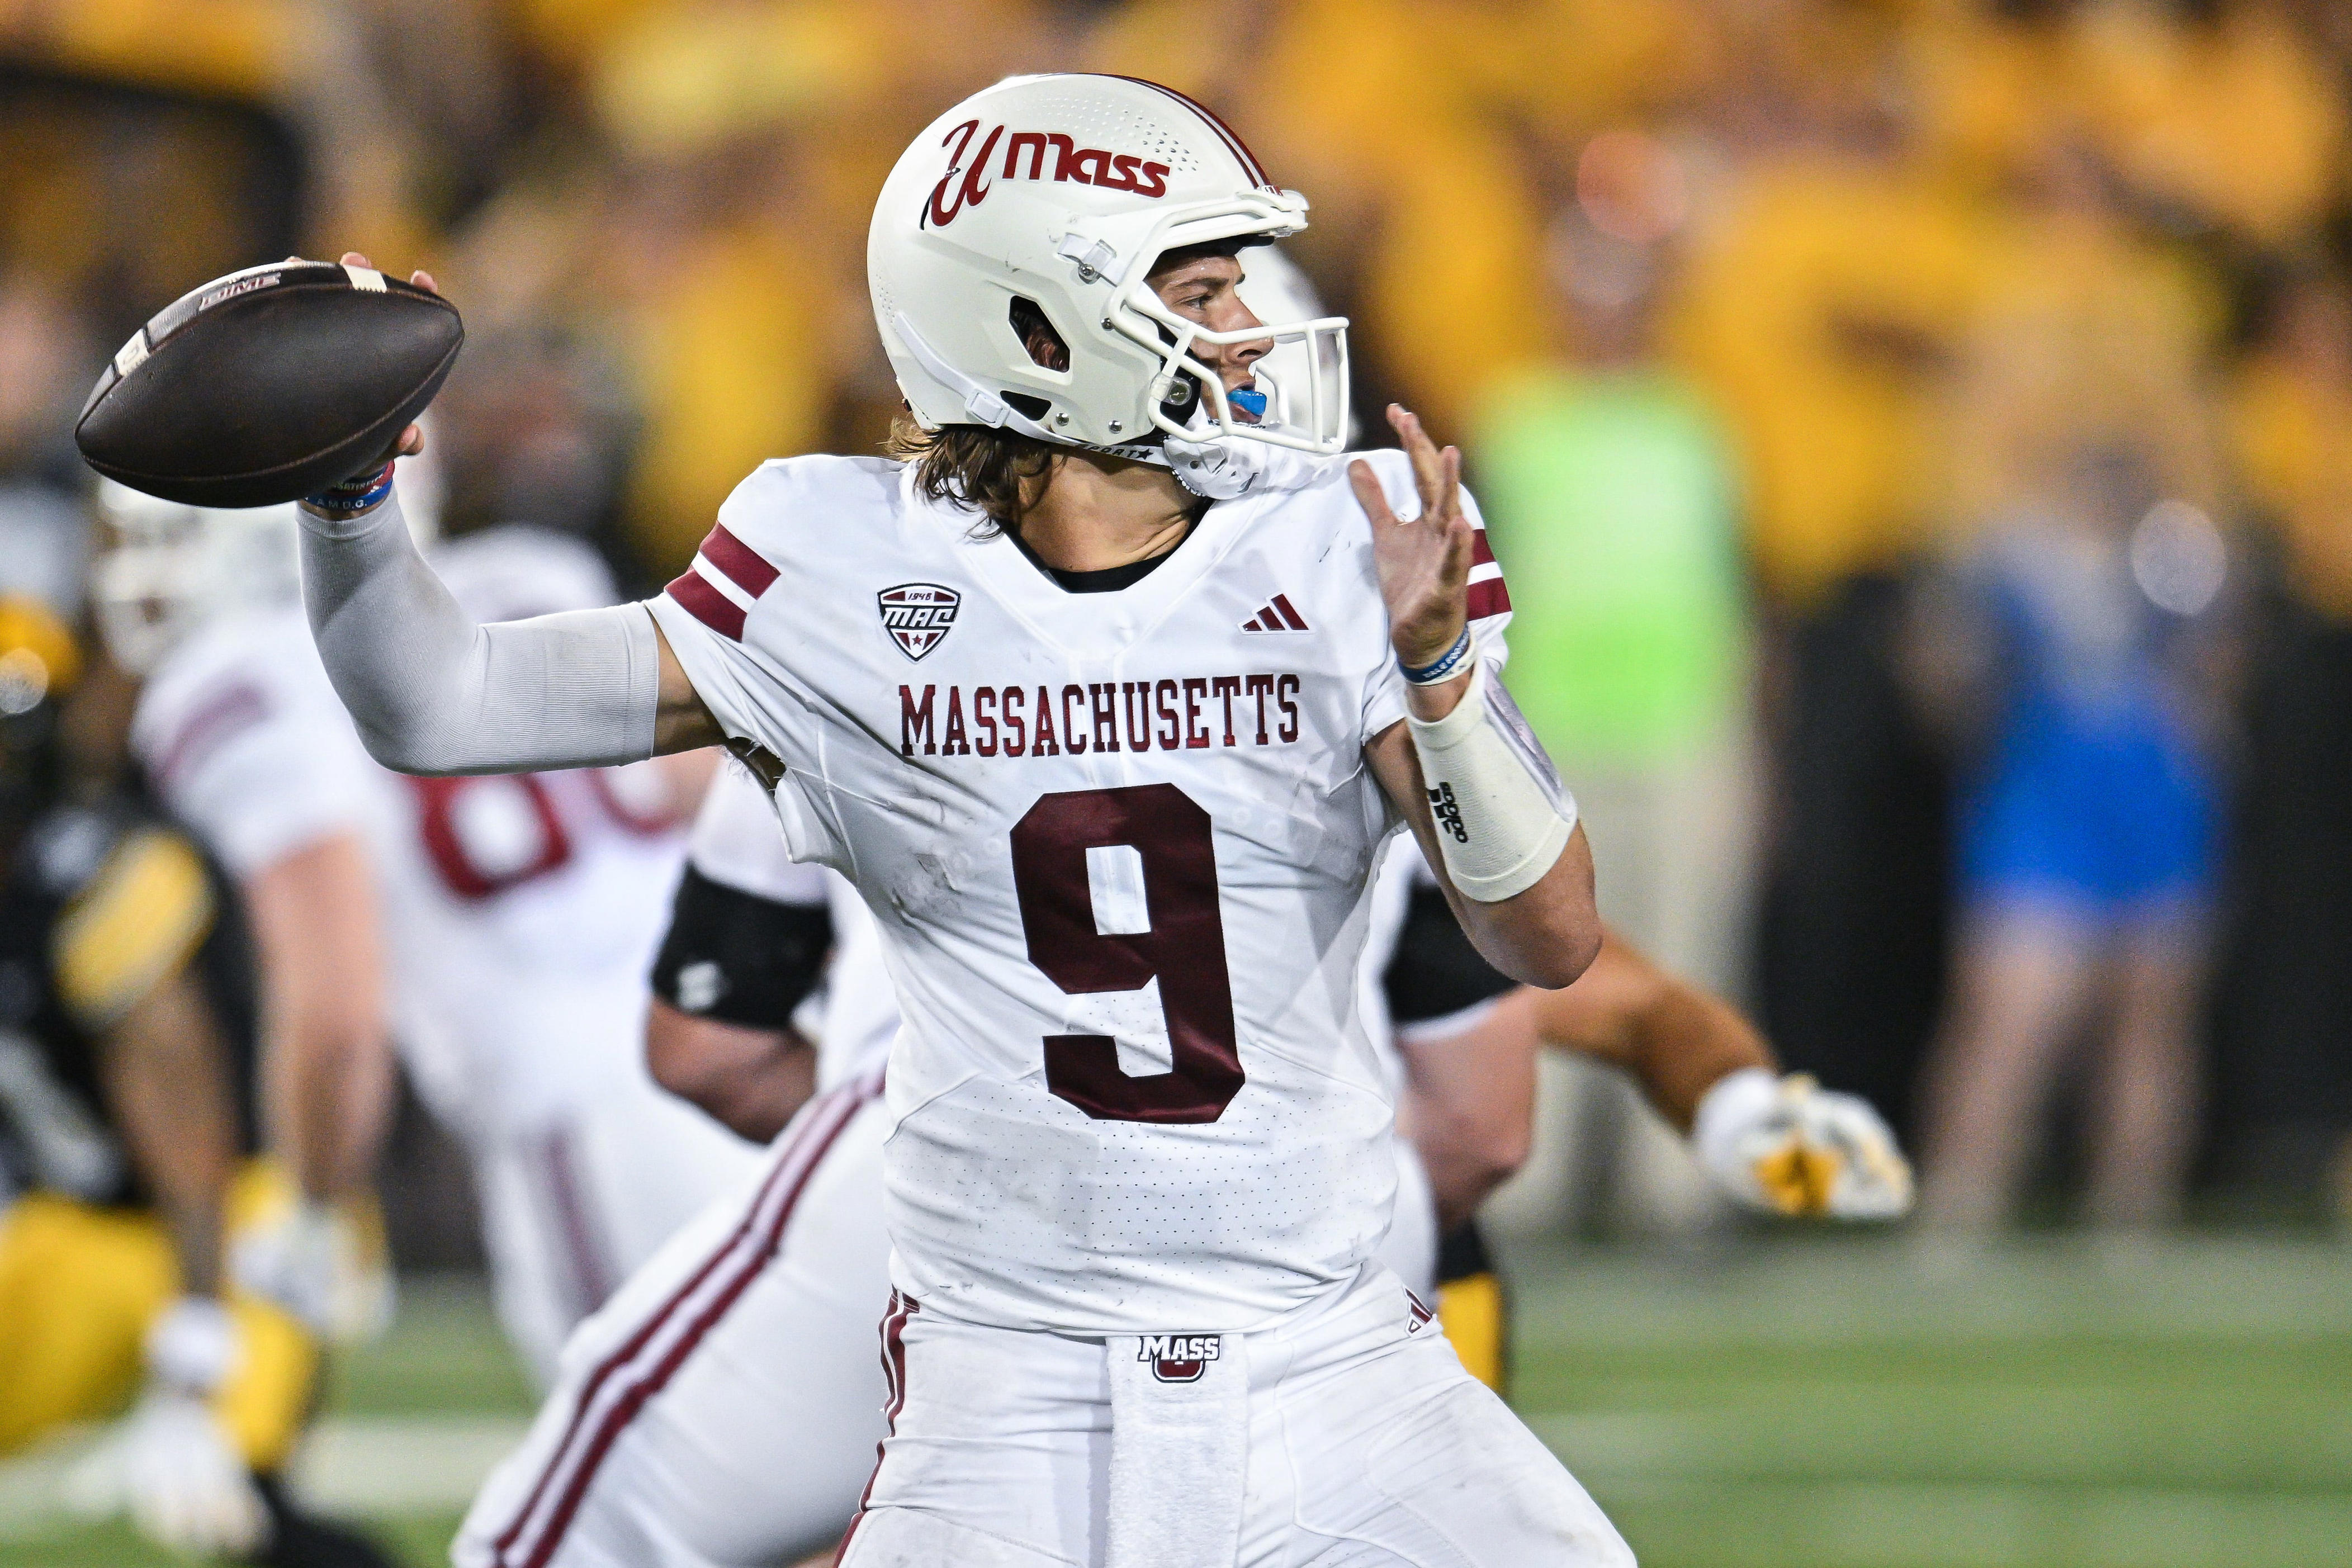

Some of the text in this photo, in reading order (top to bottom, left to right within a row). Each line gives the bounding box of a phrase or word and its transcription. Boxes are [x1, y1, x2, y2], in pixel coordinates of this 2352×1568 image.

[883, 608, 954, 627] MAC
[898, 674, 1300, 757] MASSACHUSETTS
[1010, 783, 1246, 1125] 9
[1138, 1335, 1220, 1361] MASS
